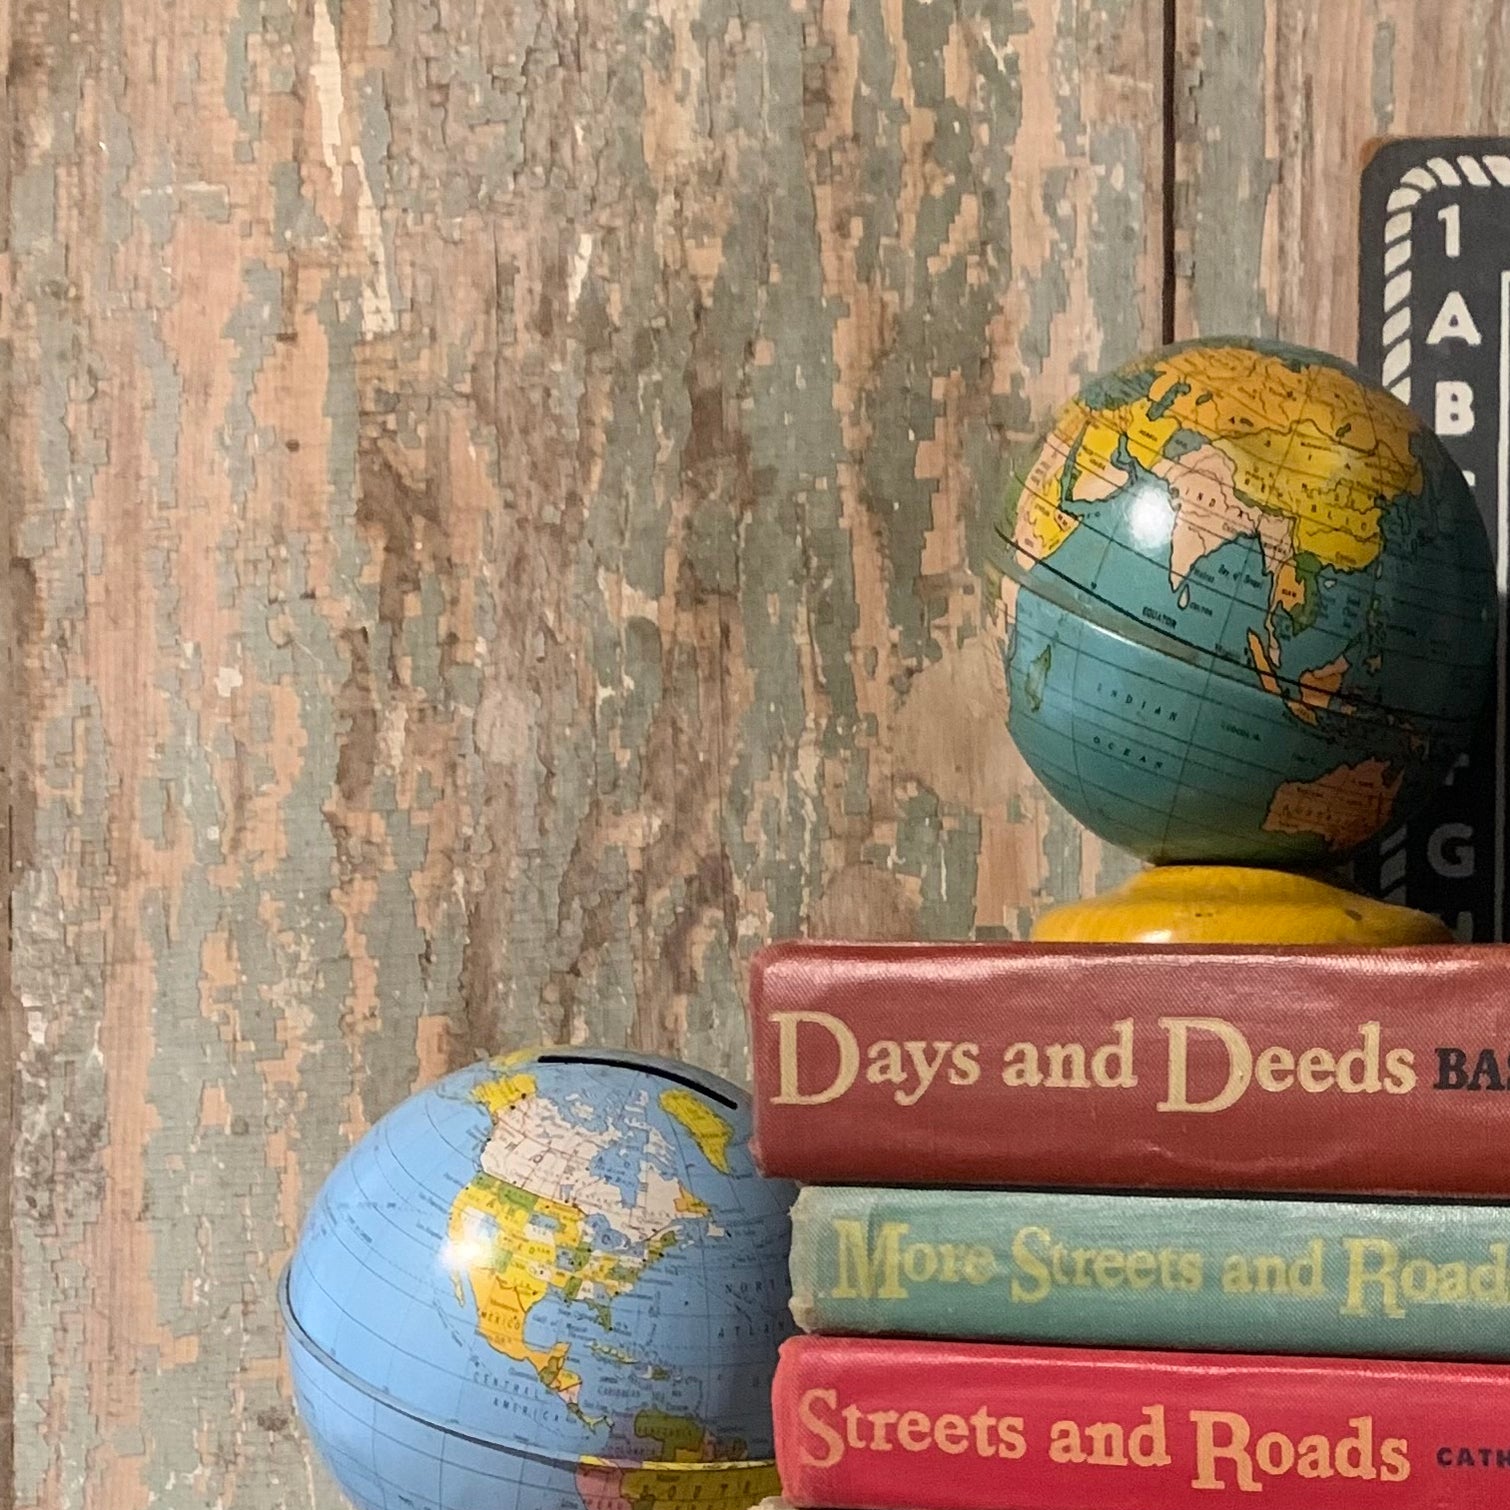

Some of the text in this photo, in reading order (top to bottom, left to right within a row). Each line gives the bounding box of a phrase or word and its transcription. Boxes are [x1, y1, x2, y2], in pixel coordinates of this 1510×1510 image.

[1437, 204, 1461, 257] 1
[1426, 291, 1482, 346] A
[1434, 381, 1475, 436] B
[1142, 606, 1178, 630] EQUATOR
[1097, 682, 1178, 721] INDIAN
[1093, 736, 1163, 769] OCEAN
[1426, 822, 1475, 879] G
[768, 1010, 982, 1108] Days
[1001, 1019, 1138, 1090] and
[1156, 1016, 1418, 1114] Deeds
[831, 1218, 996, 1301] More
[1010, 1225, 1203, 1303] Streets
[1221, 1240, 1325, 1297] and
[799, 1386, 1027, 1470] Streets
[1048, 1404, 1172, 1468] and
[1190, 1409, 1411, 1493] Roads
